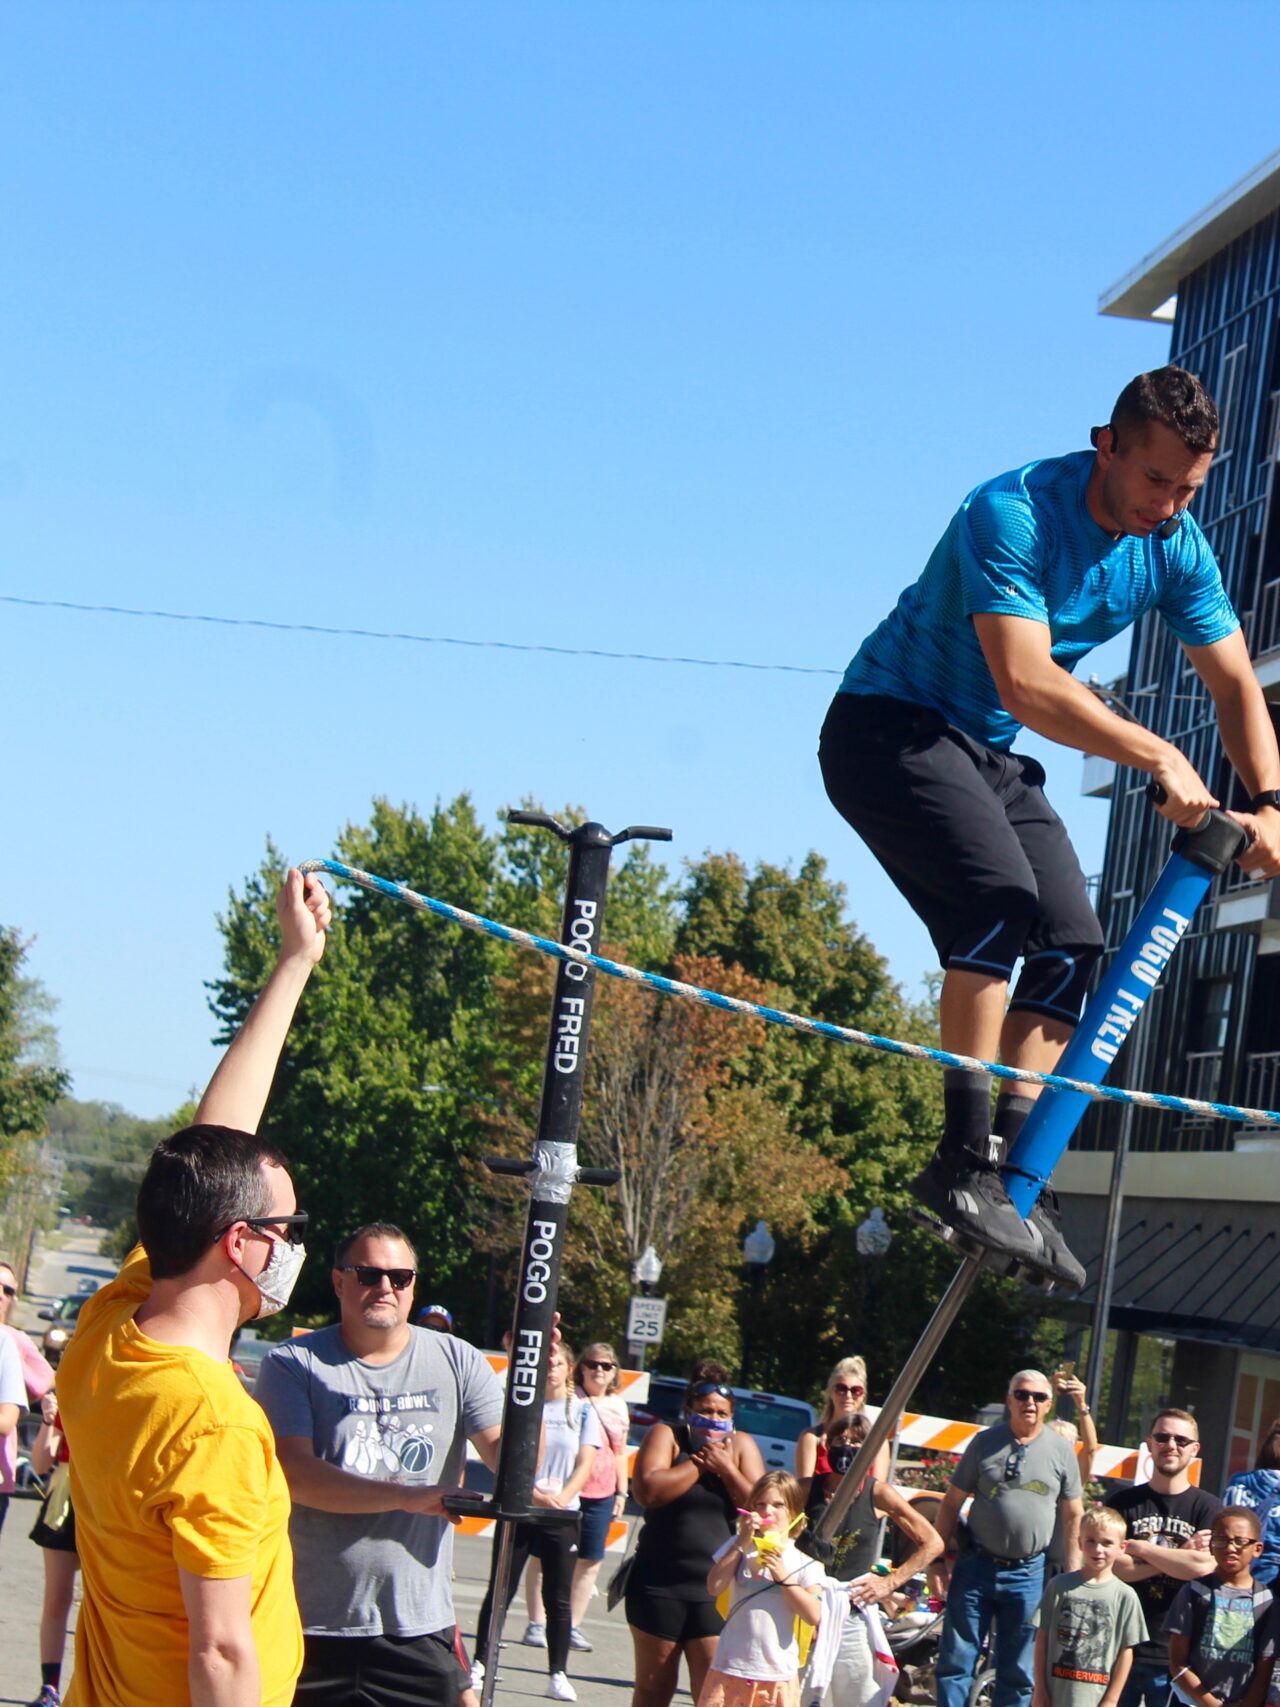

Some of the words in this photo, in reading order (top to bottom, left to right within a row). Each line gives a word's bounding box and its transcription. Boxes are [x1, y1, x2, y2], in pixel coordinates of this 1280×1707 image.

[553, 996, 585, 1075] FRED
[523, 1219, 558, 1304] POGO
[633, 1320, 659, 1337] 25
[511, 1329, 543, 1407] FRED
